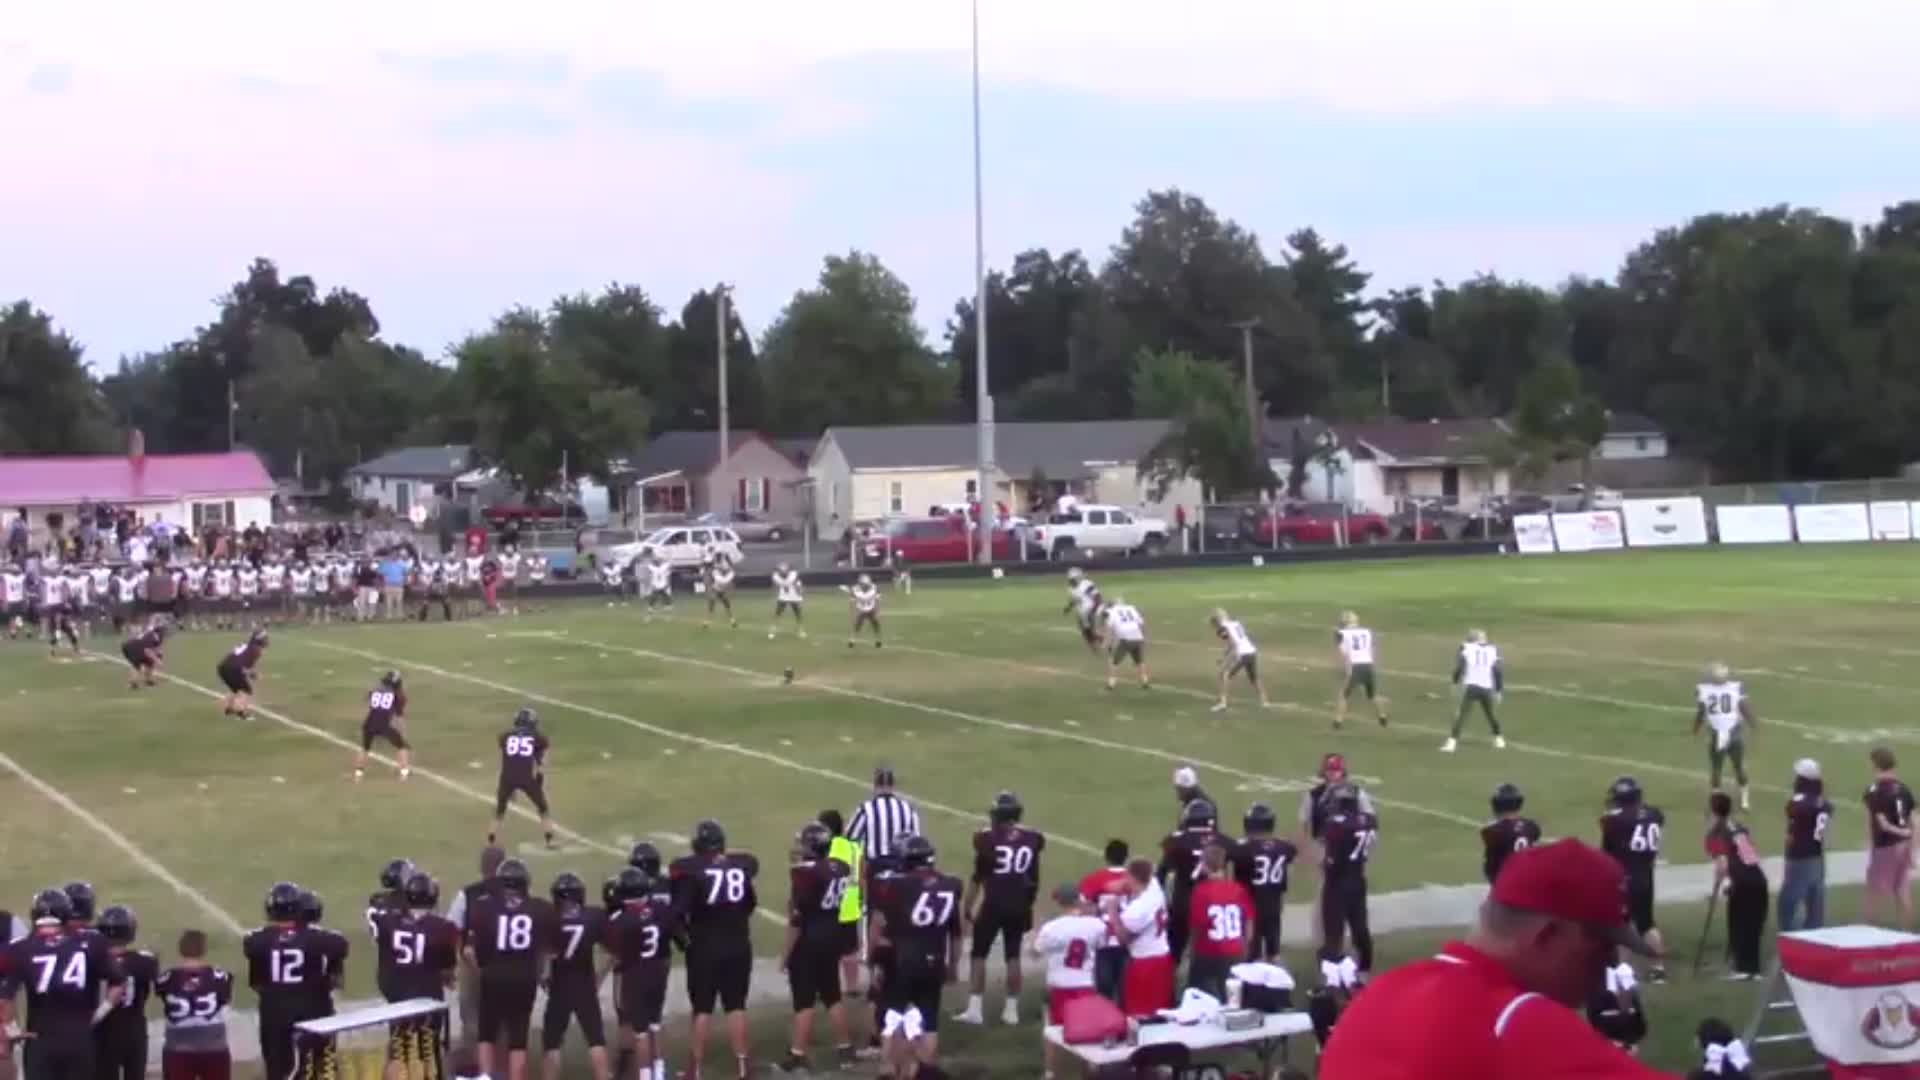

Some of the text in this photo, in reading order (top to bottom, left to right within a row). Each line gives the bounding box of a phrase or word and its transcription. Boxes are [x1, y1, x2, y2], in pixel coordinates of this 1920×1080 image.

[1708, 693, 1732, 714] 20
[506, 736, 535, 756] 85
[1631, 823, 1660, 851] 60
[993, 845, 1033, 874] 30
[1252, 855, 1286, 886] 36
[704, 868, 745, 904] 78
[911, 891, 954, 926] 67
[1207, 904, 1242, 940] 30
[393, 931, 425, 964] 51
[497, 914, 533, 951] 18
[561, 924, 585, 960] 7
[640, 925, 660, 958] 3
[31, 951, 87, 994] 74
[271, 949, 304, 983] 12
